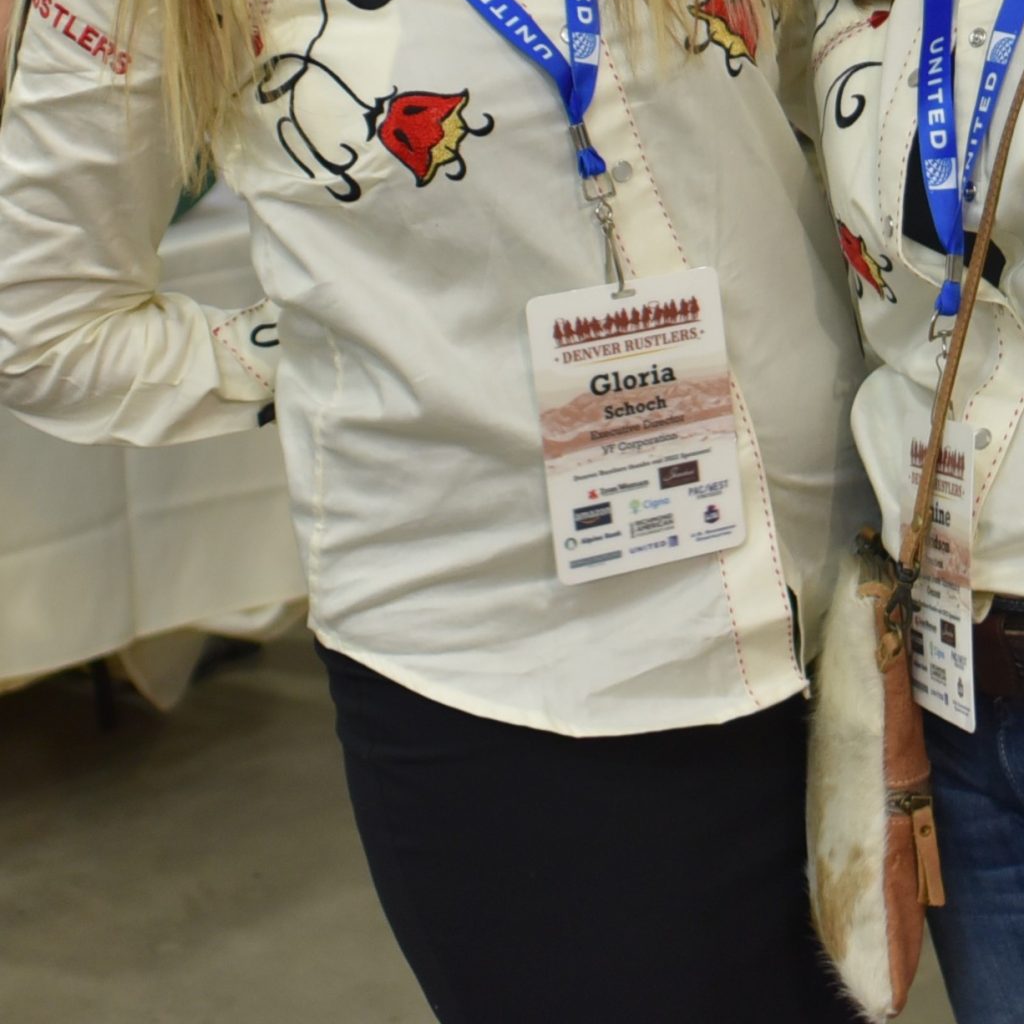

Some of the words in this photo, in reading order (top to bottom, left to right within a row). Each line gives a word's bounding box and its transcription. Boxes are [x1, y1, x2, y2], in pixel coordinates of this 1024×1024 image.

[928, 36, 948, 150] UNITED
[964, 72, 998, 172] NITED
[562, 342, 621, 365] DENVER
[624, 328, 698, 352] RUSTLERS
[590, 364, 677, 396] Gloria
[604, 395, 668, 420] Schoch
[618, 432, 678, 453] Corporation
